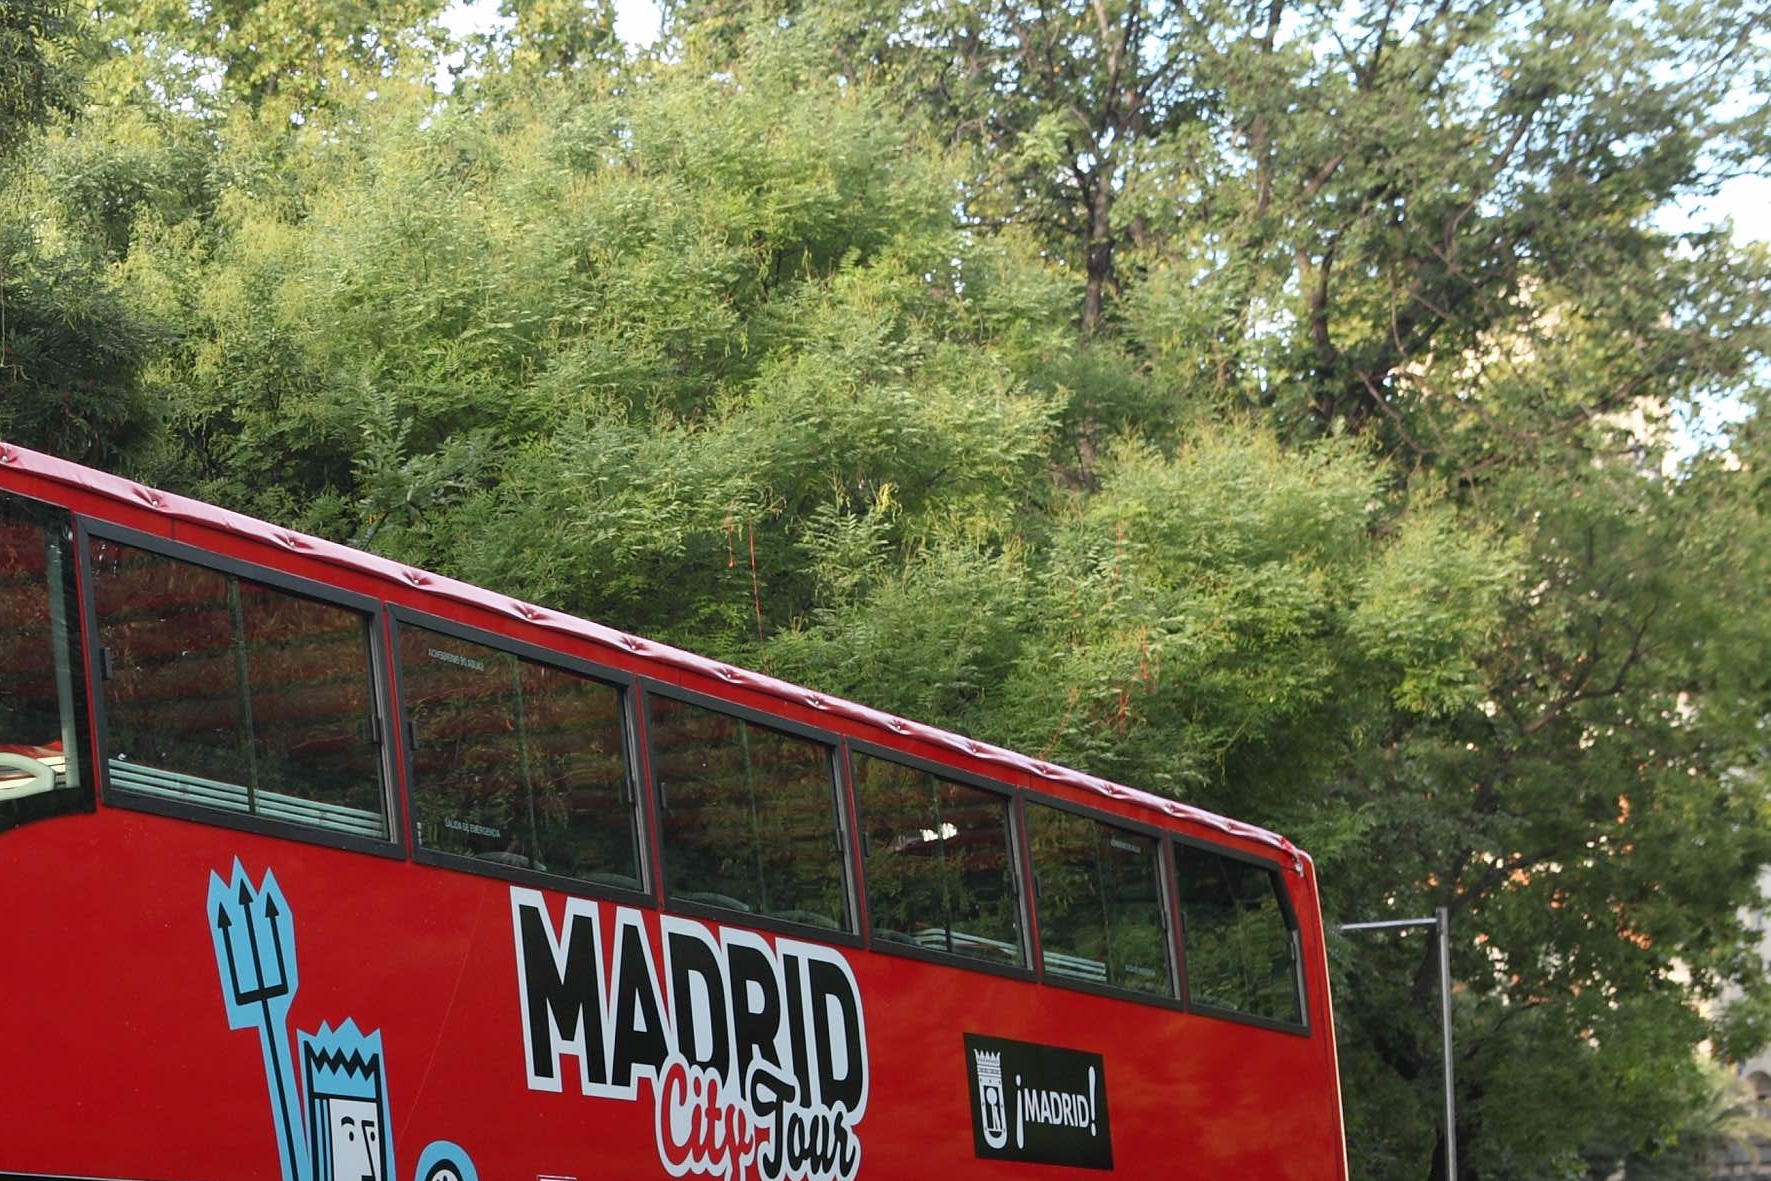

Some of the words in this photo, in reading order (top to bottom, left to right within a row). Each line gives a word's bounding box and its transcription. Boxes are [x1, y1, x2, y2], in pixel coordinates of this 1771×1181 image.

[517, 903, 865, 1114] MADRID
[750, 1067, 857, 1180] Tour
[1015, 1065, 1097, 1150] ¡MADRID!
